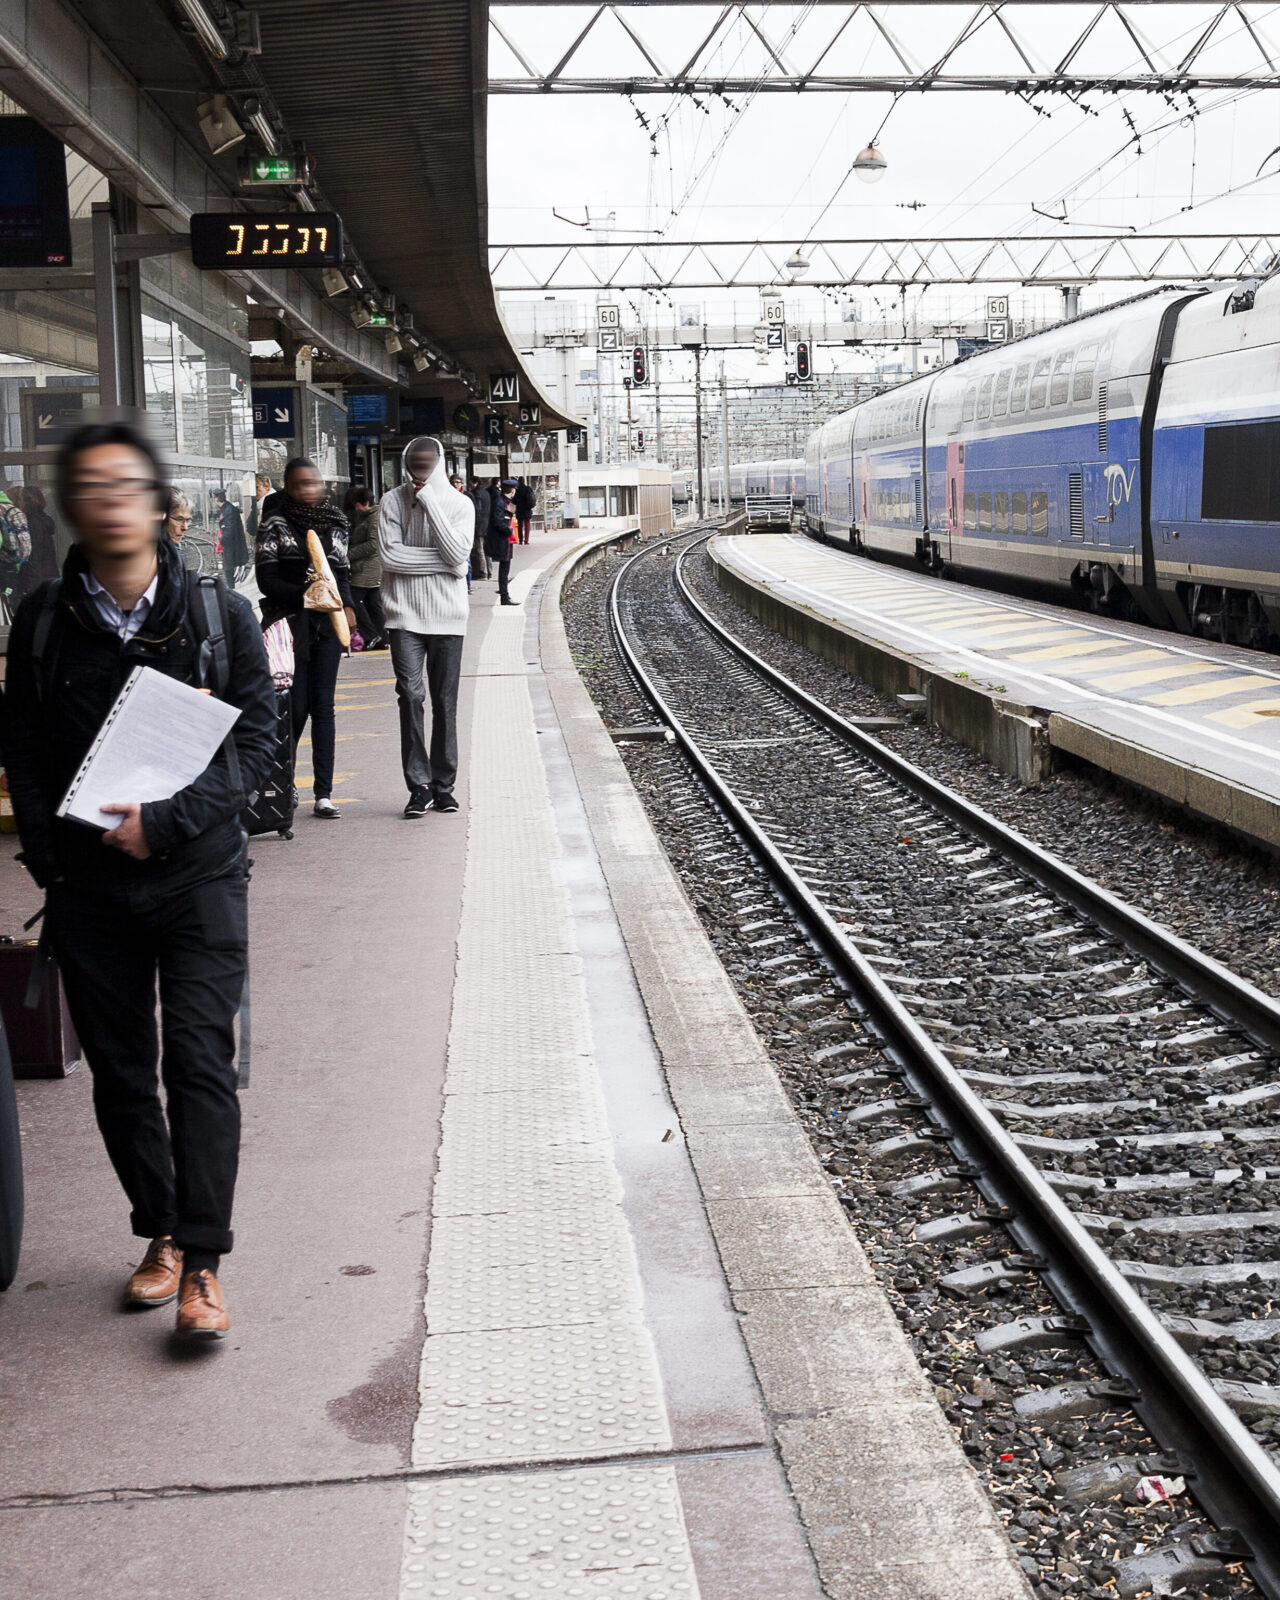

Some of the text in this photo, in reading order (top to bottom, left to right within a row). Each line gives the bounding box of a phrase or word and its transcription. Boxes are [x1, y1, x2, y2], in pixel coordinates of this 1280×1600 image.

[767, 306, 781, 318] 60
[991, 301, 1004, 313] 60
[601, 310, 615, 322] 60
[492, 377, 514, 397] 4V
[255, 411, 262, 421] B
[489, 418, 501, 434] R
[1103, 462, 1136, 506] TGV
